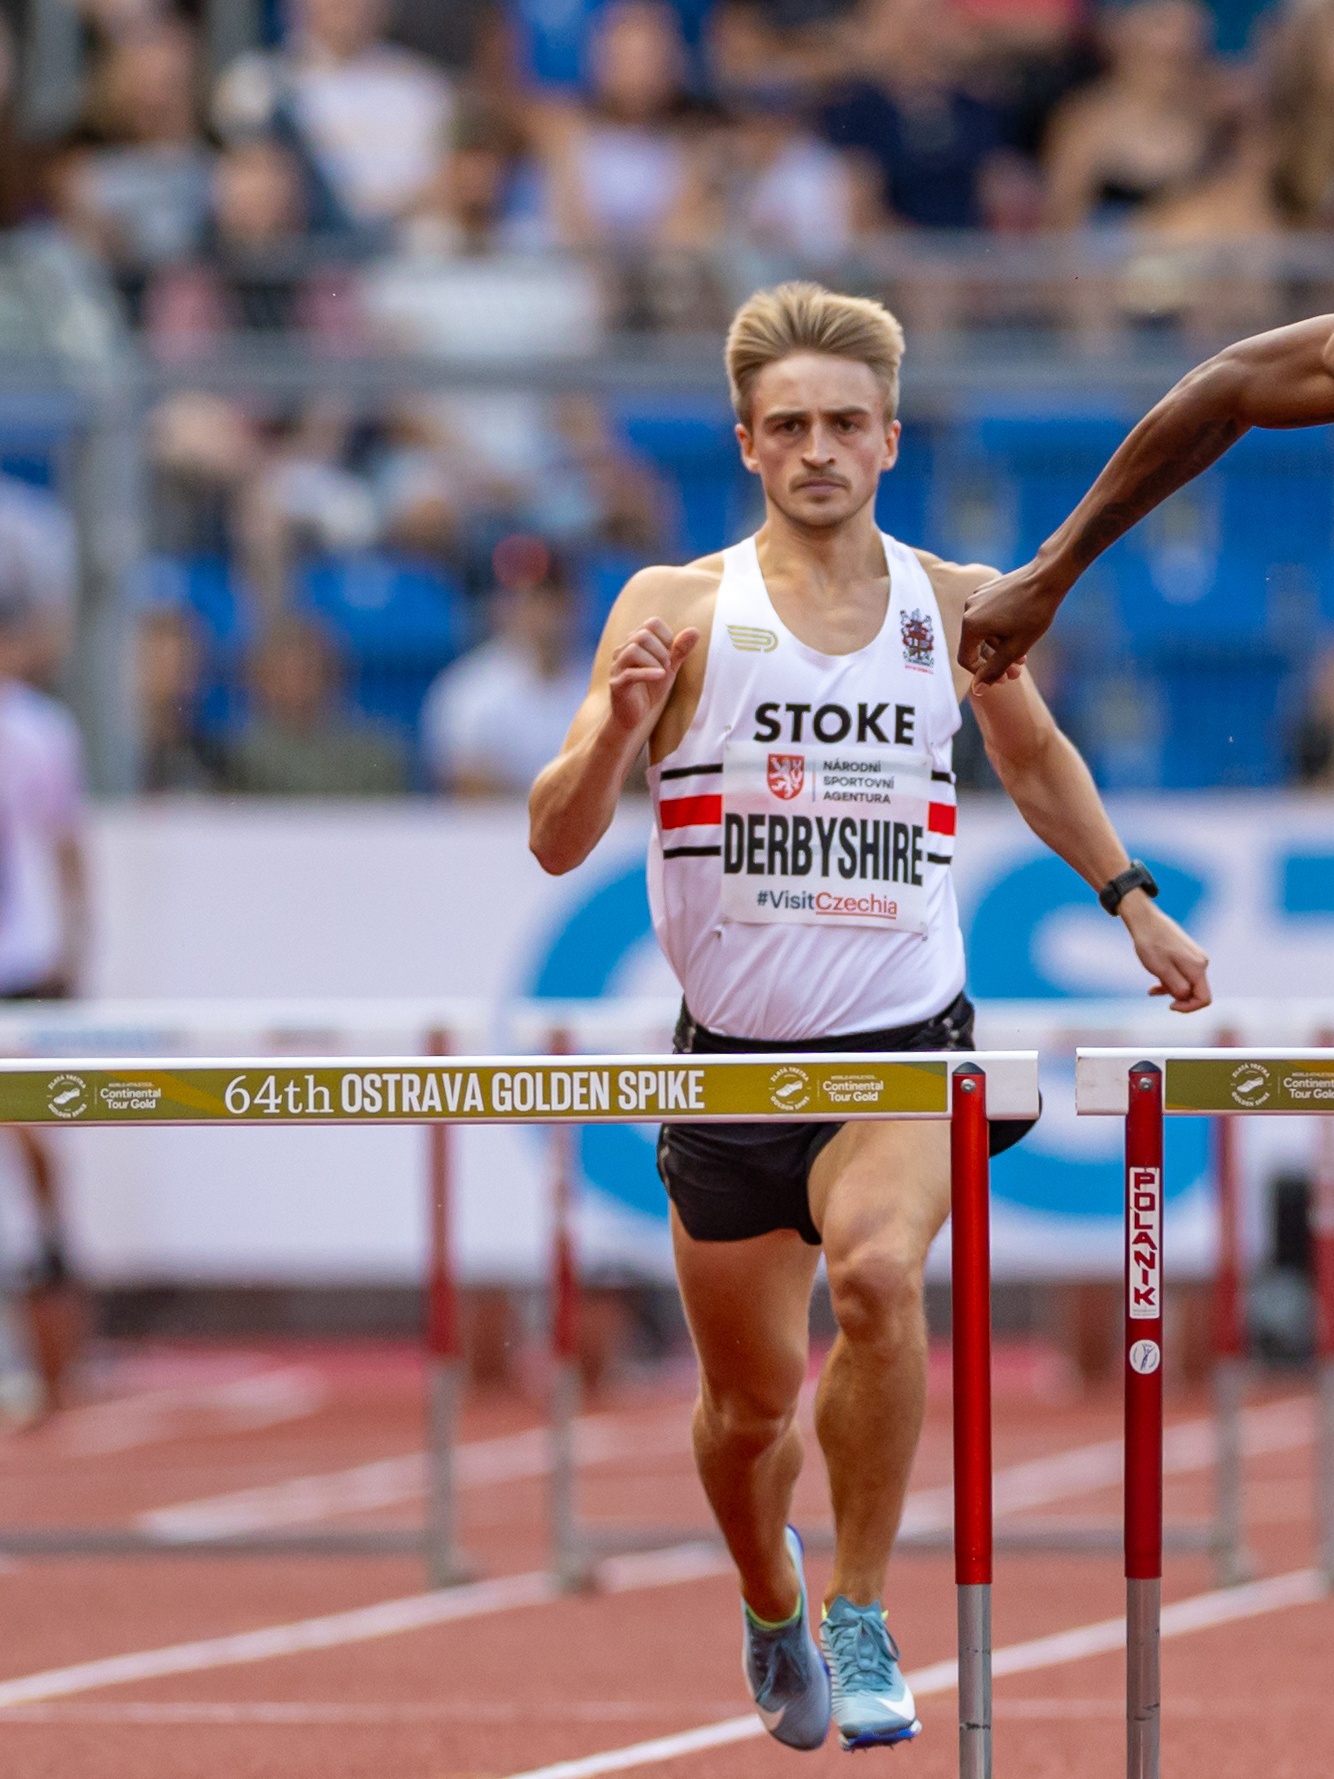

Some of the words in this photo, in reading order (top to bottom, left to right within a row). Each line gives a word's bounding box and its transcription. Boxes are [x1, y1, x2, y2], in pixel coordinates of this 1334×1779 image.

[753, 703, 915, 745] STOKE
[823, 760, 881, 773] NÁRODNÍ
[823, 775, 895, 789] SPORTOVNÍ
[823, 791, 891, 804] AGENTURA
[724, 812, 924, 887] DERBYSHIRE
[756, 891, 898, 916] #VisitCzechia
[224, 1075, 334, 1114] 64th
[341, 1073, 485, 1112] OSTRAVA
[491, 1071, 610, 1111] GOLDEN
[618, 1070, 705, 1110] SPIKE
[823, 1080, 884, 1092] Continental
[100, 1088, 161, 1099] Continental
[829, 1092, 852, 1102] Tour
[853, 1090, 879, 1102] Gold
[1290, 1088, 1312, 1100] Tour
[106, 1099, 129, 1110] Tour
[130, 1098, 156, 1110] Gold
[1132, 1171, 1157, 1306] POLANIK
